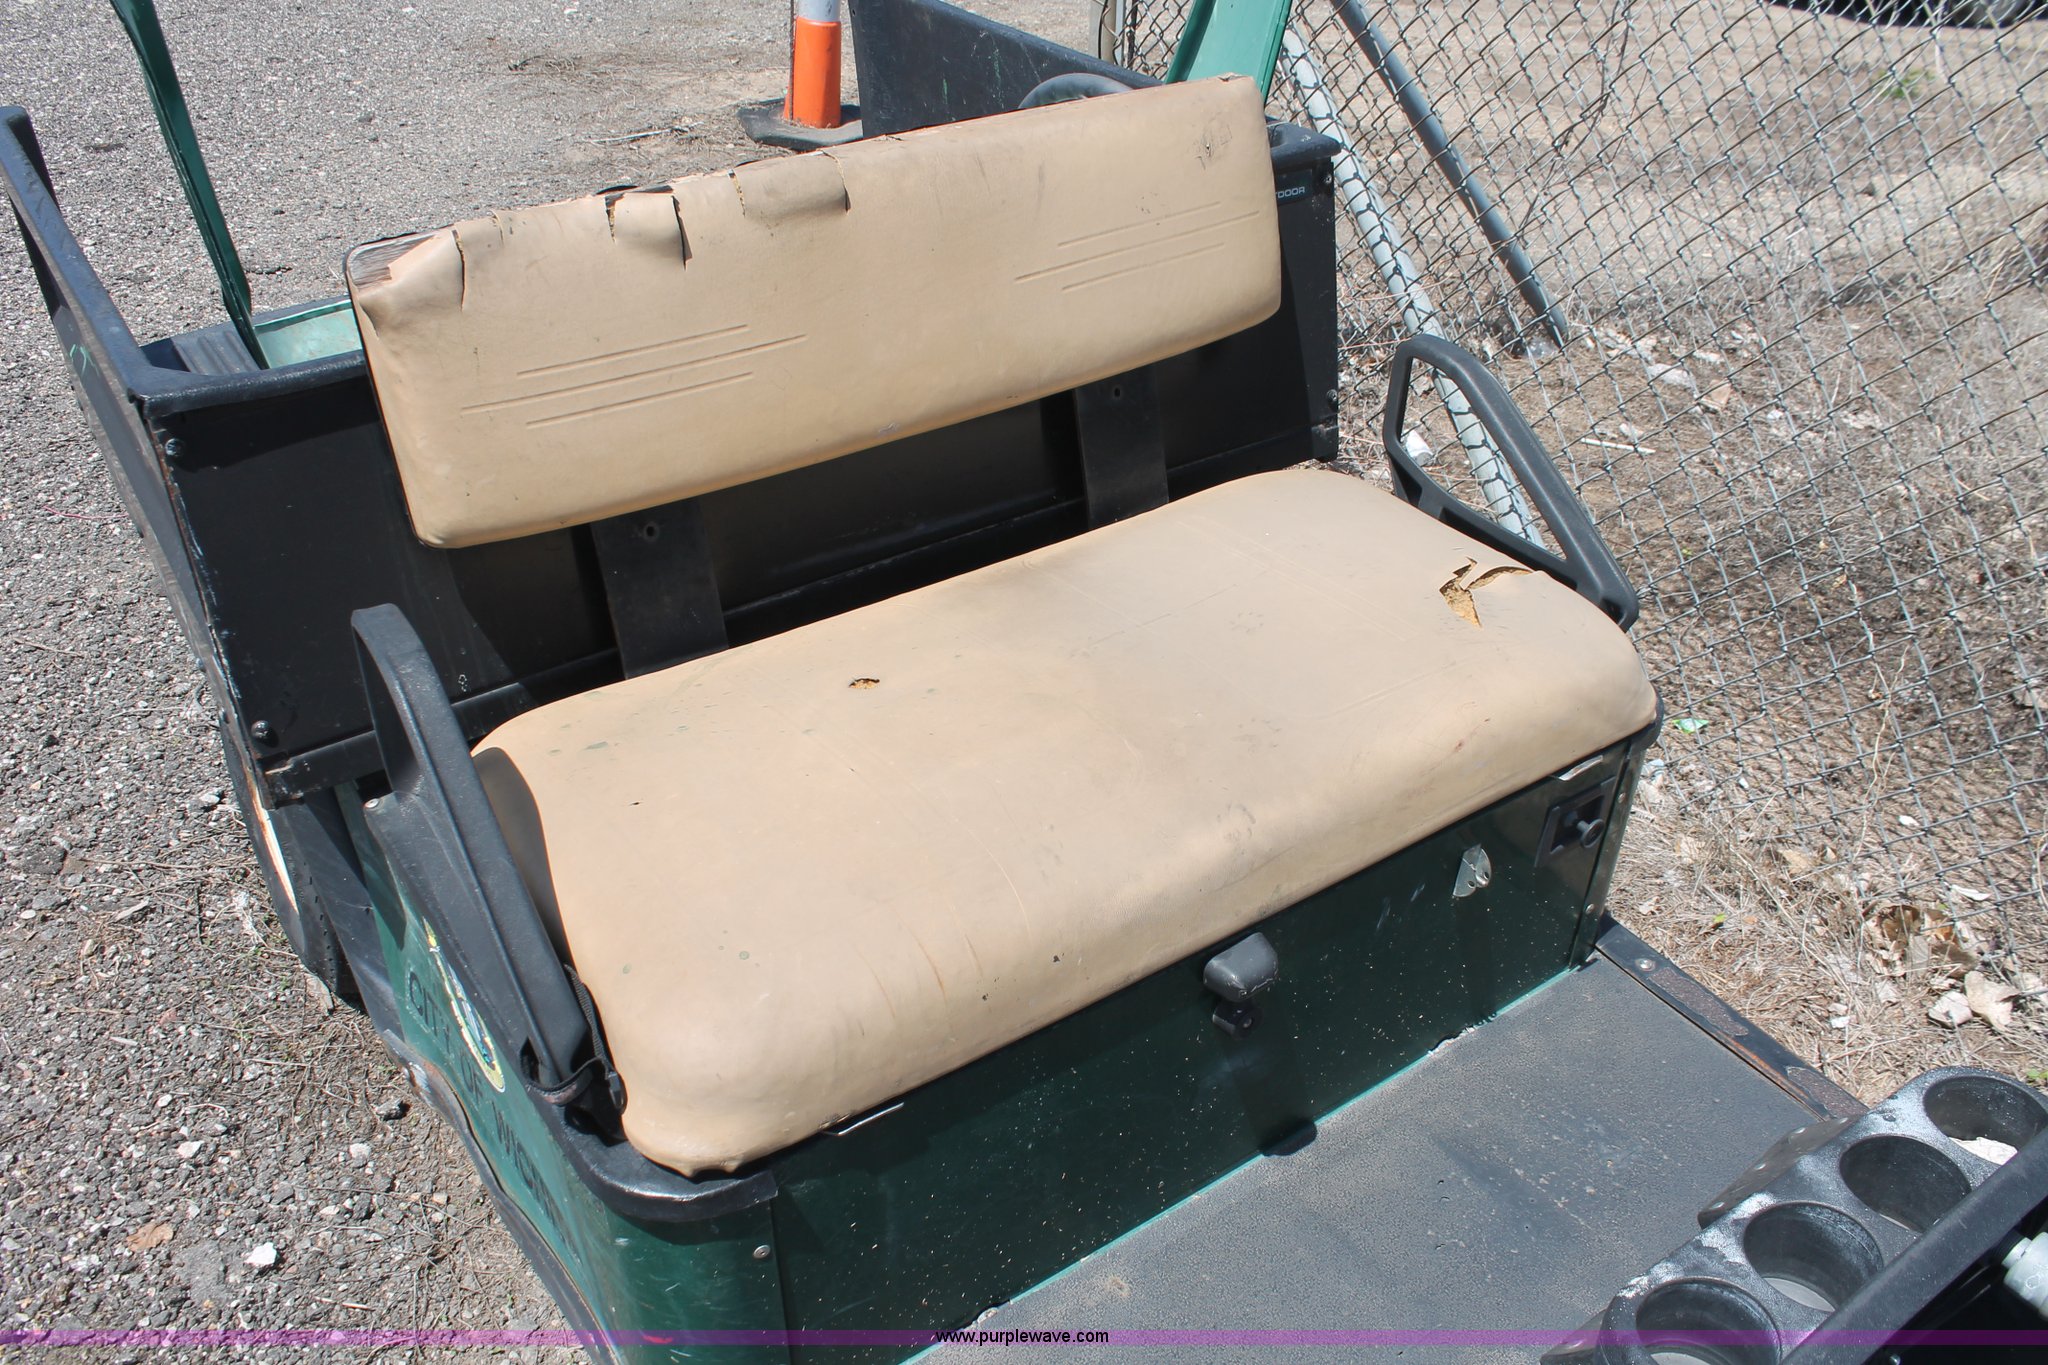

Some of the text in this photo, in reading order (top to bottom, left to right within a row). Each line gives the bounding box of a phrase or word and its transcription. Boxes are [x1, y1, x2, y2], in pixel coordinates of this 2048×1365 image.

[1275, 186, 1306, 199] DOOR
[409, 971, 452, 1055] CITY
[460, 1053, 484, 1104] OF
